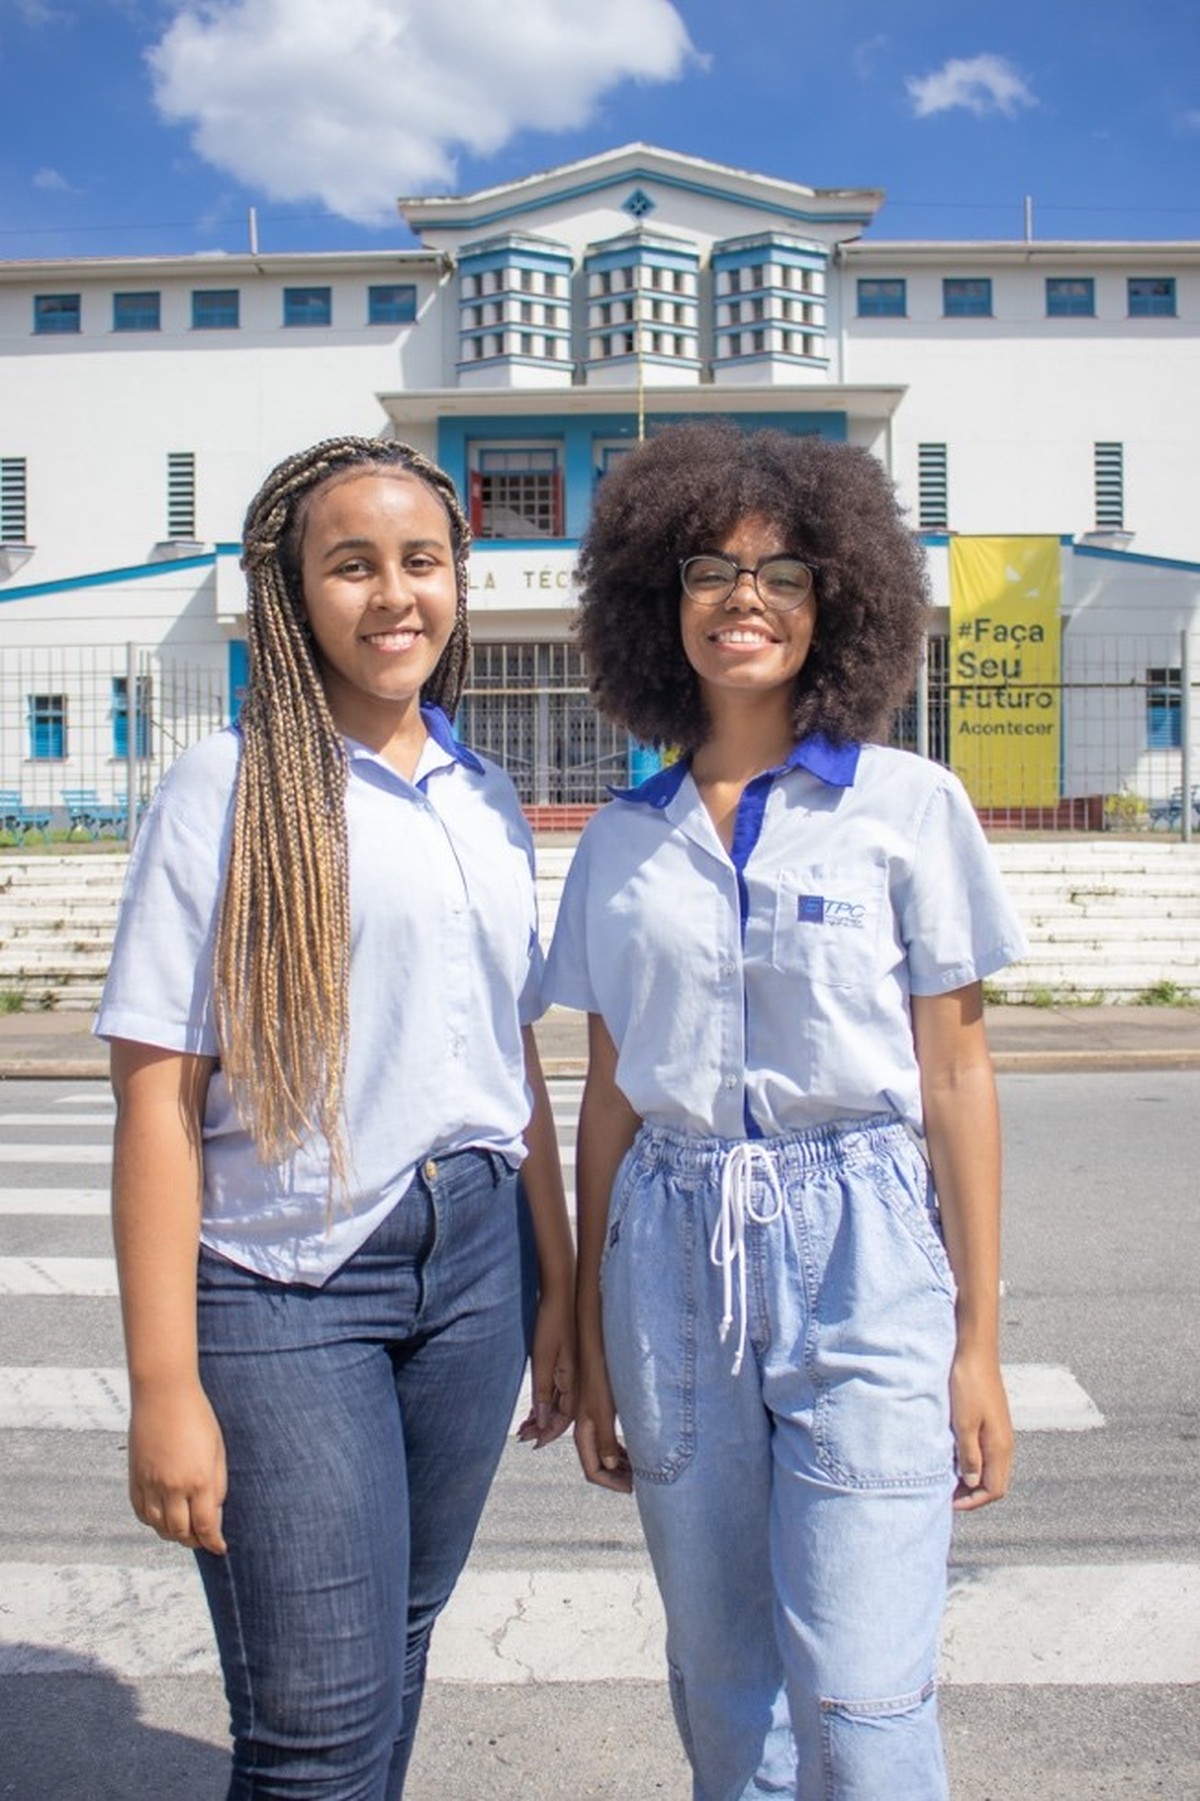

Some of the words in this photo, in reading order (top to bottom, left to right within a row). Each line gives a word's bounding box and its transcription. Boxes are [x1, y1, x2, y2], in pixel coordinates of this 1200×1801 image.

[468, 571, 496, 590] LA
[523, 565, 568, 590] TÉC
[957, 618, 1045, 648] #Faça
[957, 651, 1022, 679] Seu
[957, 687, 1054, 709] Futuro
[958, 720, 1054, 736] Acontecer
